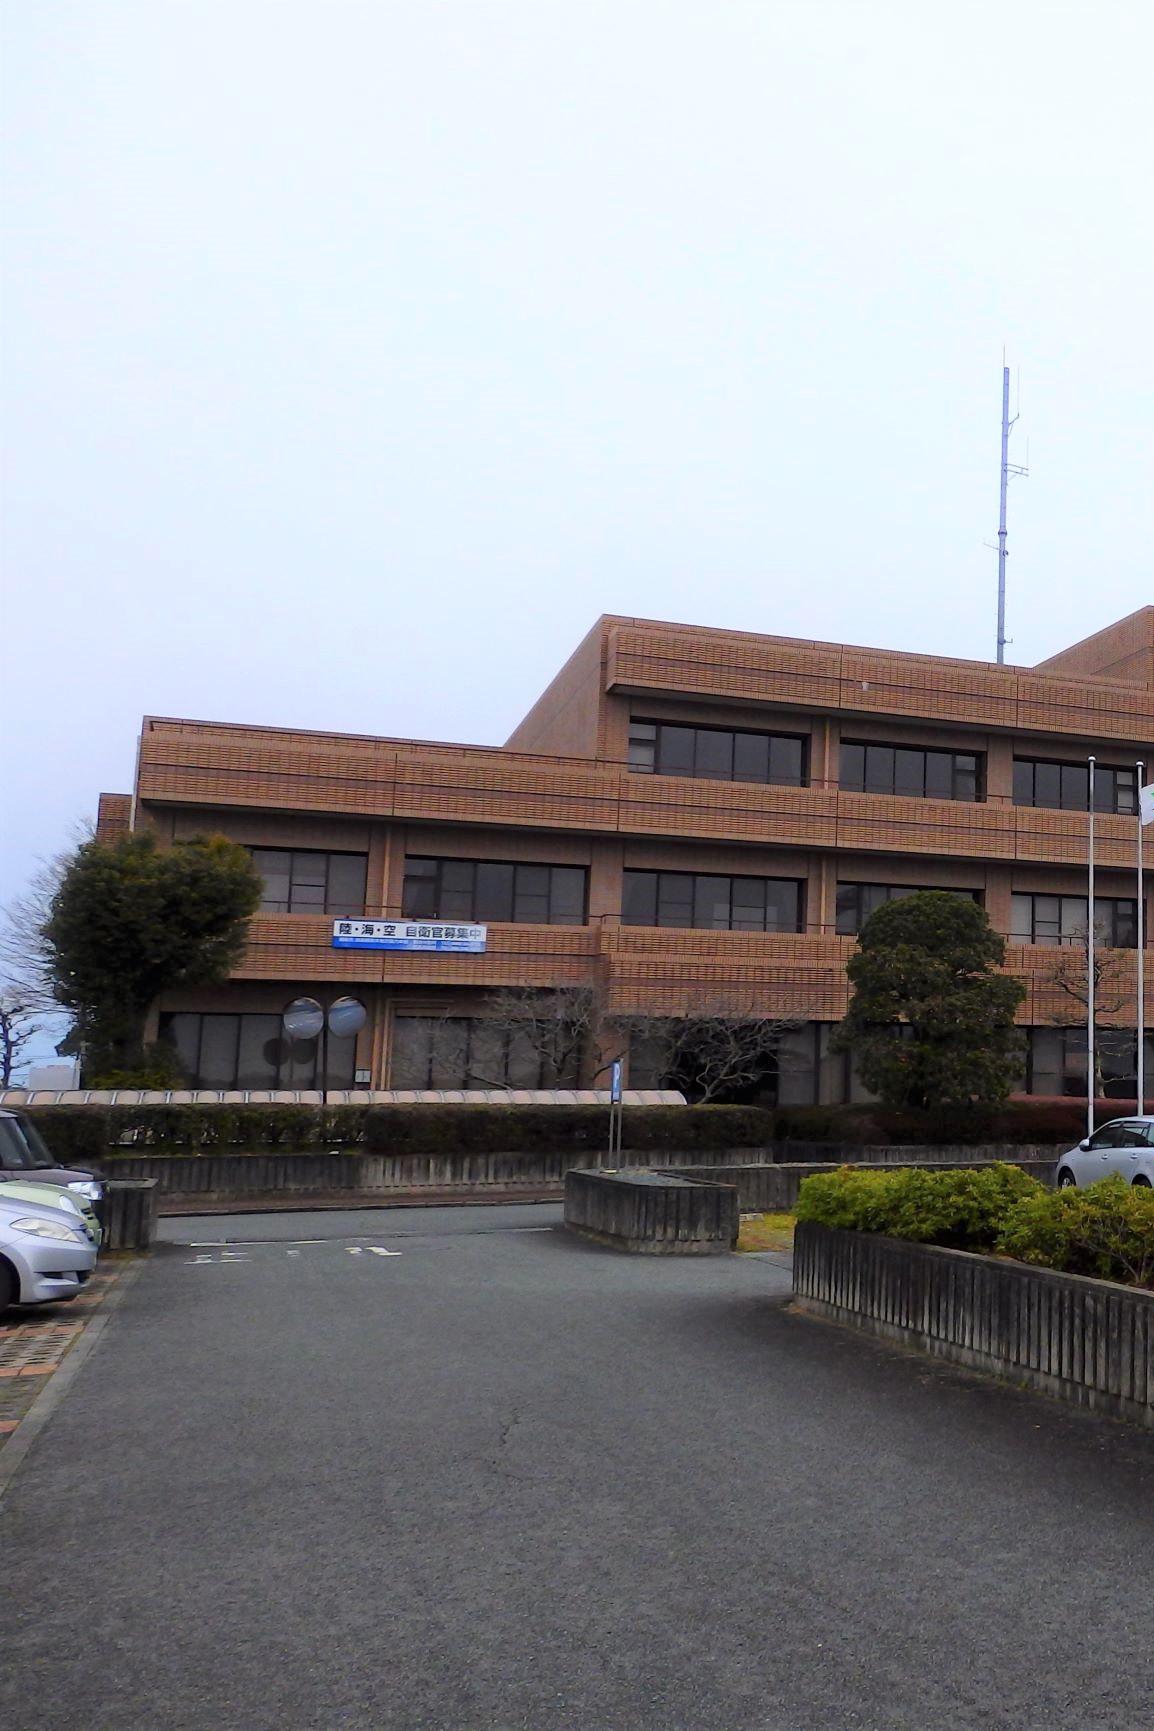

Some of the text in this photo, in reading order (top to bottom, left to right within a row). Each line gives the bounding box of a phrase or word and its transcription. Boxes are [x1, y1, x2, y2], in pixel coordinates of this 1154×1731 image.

[339, 923, 481, 939] 陸・海・空 自衛官募集中
[613, 1063, 620, 1088] P
